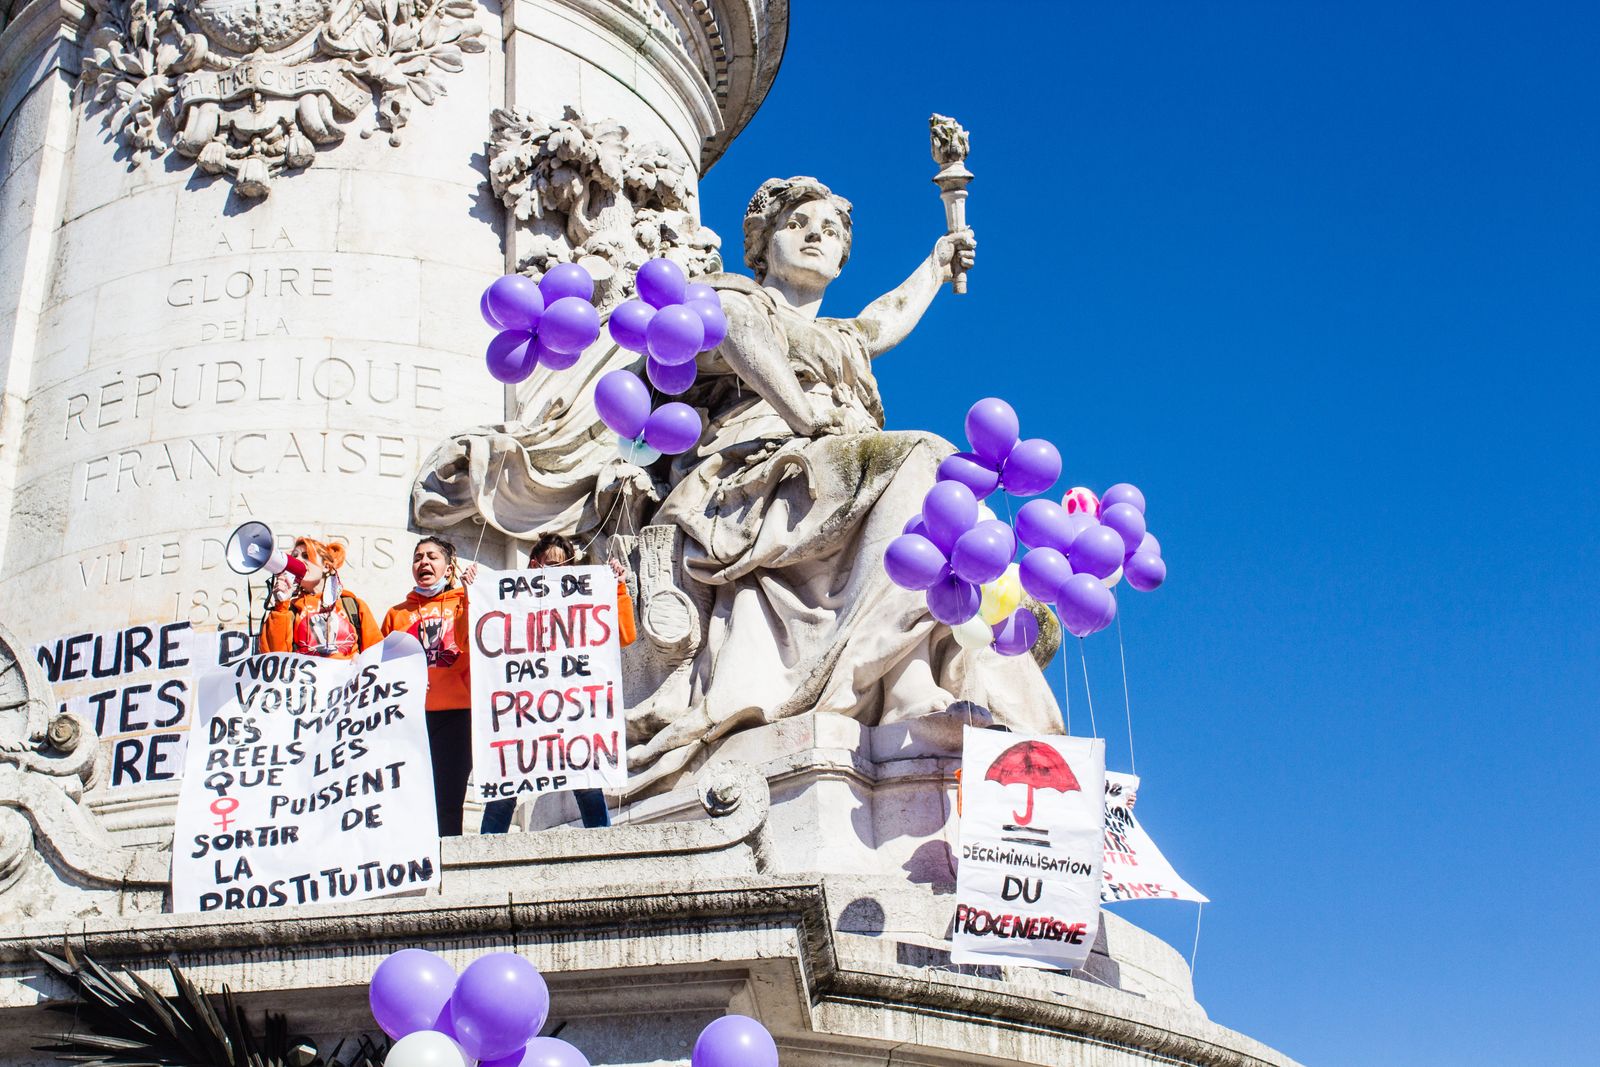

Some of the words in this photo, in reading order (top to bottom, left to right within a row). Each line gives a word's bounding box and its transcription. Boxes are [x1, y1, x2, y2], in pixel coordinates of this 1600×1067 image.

[213, 232, 233, 252] A
[250, 227, 294, 249] LA
[167, 267, 332, 307] GLOIRE
[201, 321, 238, 341] DE
[256, 317, 290, 336] LA
[84, 432, 406, 501] FRANÇAISE
[209, 492, 253, 518] LA
[79, 542, 180, 589] VILLE
[499, 575, 550, 600] PAS
[561, 574, 592, 598] DE
[475, 604, 612, 658] CLIENTS
[235, 654, 318, 685] NOUS
[235, 664, 380, 715] VOULONS
[506, 657, 550, 683] PAS
[561, 655, 591, 678] DE
[60, 679, 188, 737] TES
[209, 716, 262, 744] DES
[294, 680, 408, 740] MOYENS
[337, 703, 405, 741] POUR
[112, 733, 188, 786] RE
[203, 767, 284, 797] QUE
[313, 738, 369, 777] LES
[270, 761, 406, 819] PUISSENT
[480, 775, 567, 798] #CAPP
[191, 825, 299, 859] SORTIR
[341, 803, 383, 831] DE
[200, 856, 433, 911] PROSTITUTION
[214, 856, 253, 884] LA
[1001, 874, 1043, 903] DU
